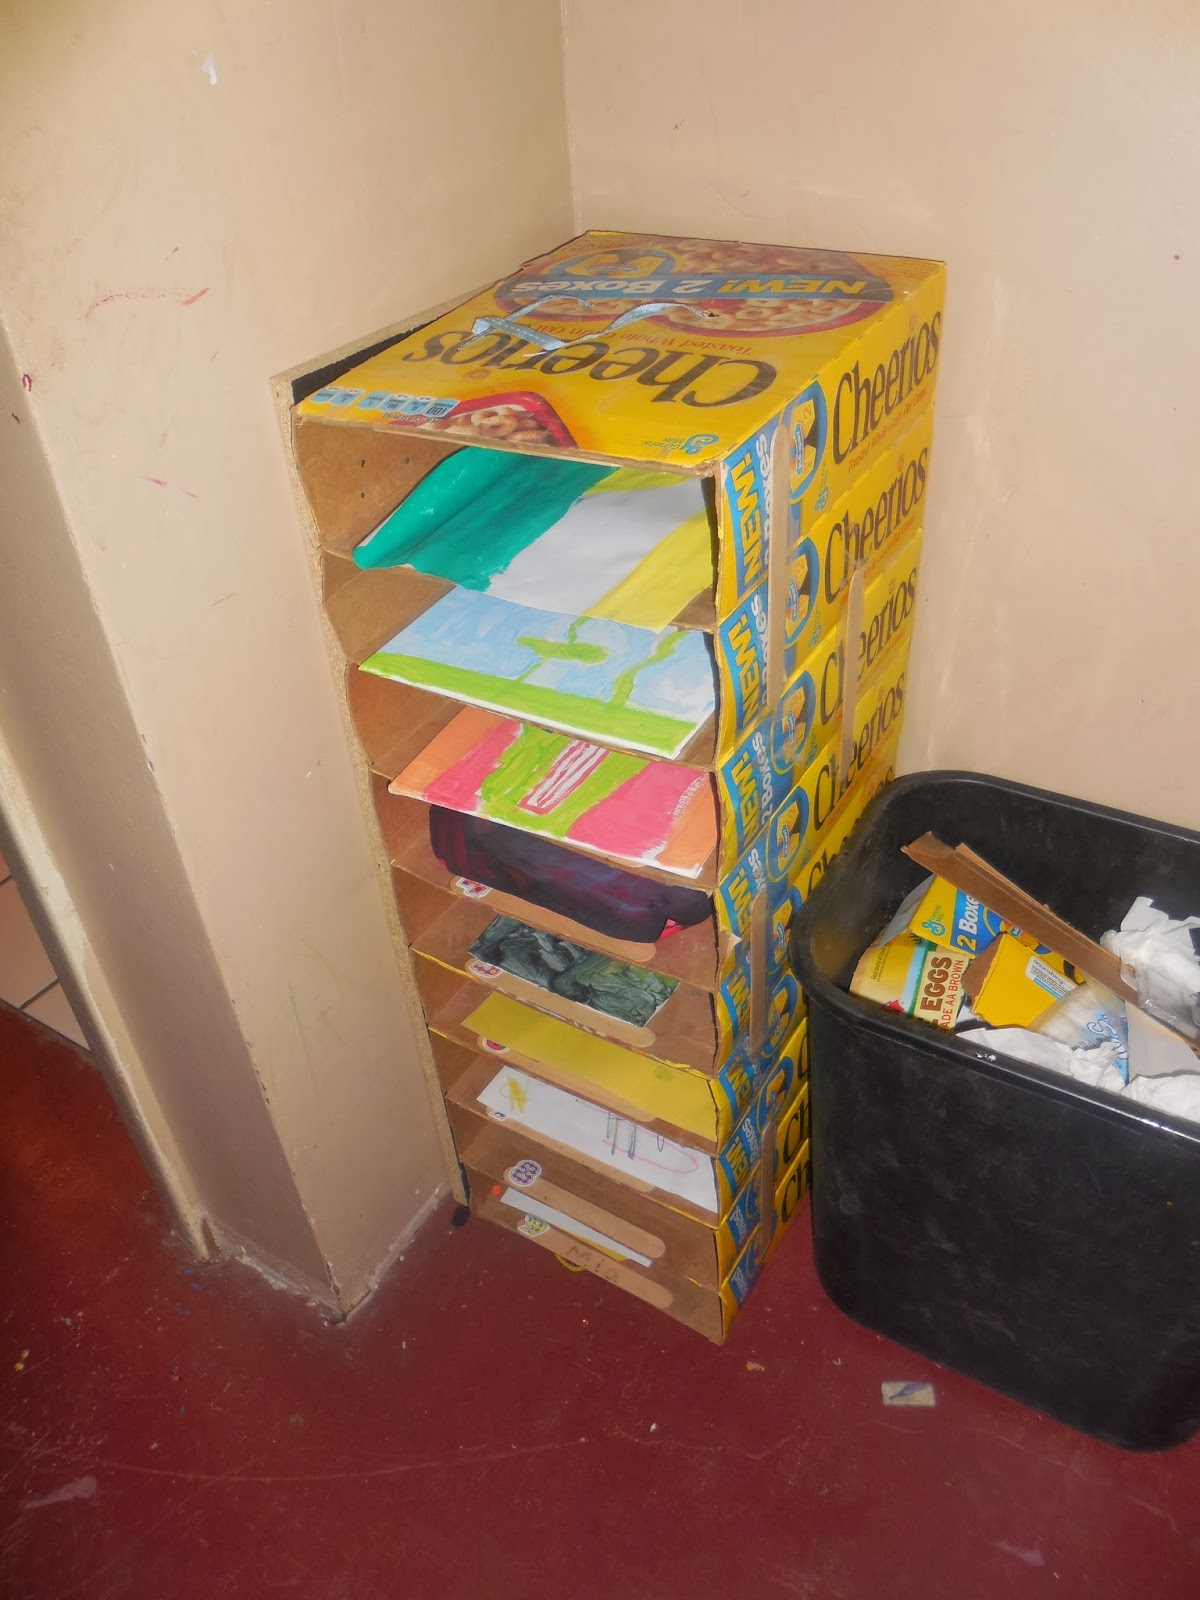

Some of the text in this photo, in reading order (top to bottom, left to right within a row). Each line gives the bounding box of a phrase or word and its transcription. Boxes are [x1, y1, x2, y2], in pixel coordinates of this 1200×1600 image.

[511, 276, 868, 295] NEW! 2 Boxes
[402, 331, 777, 409] Cheerios
[619, 331, 681, 347] Whole
[684, 339, 753, 356] Toasted
[833, 311, 941, 465] Cheerios
[642, 440, 681, 450] General
[730, 451, 762, 585] NEW!
[825, 447, 928, 604] Cheerios
[727, 613, 760, 728] NEW!
[730, 750, 760, 847] NEW!
[752, 731, 773, 810] Boxes
[956, 894, 981, 952] 2 Boxe
[920, 956, 953, 1012] EGGS
[940, 960, 965, 1030] ADE AA BROWN
[510, 1161, 540, 1186] 8
